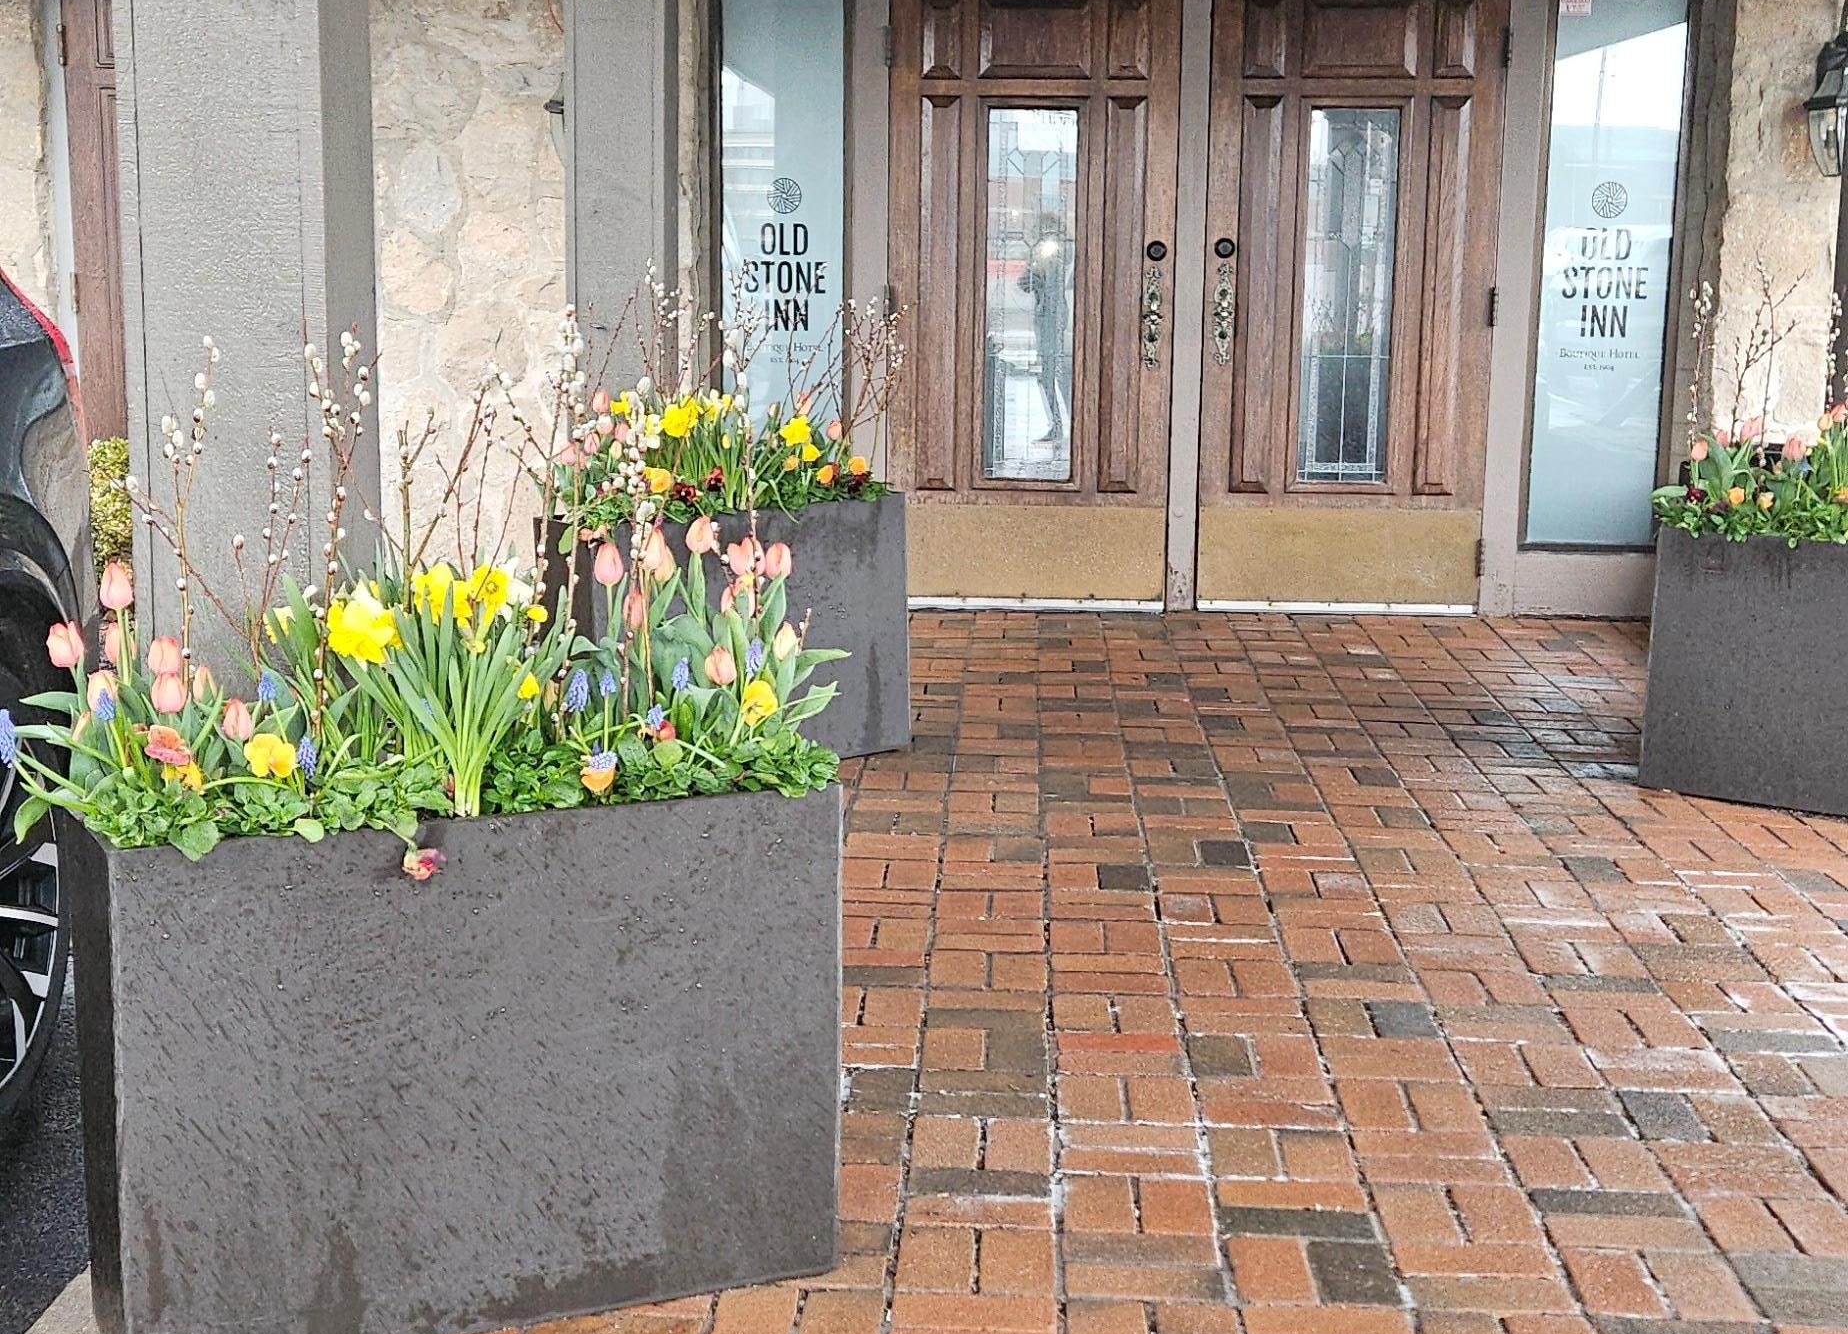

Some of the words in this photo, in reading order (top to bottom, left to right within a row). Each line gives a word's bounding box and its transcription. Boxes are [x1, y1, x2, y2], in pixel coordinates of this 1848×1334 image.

[761, 223, 808, 255] OLD
[1581, 227, 1631, 260] OLD
[744, 261, 827, 294] STONE
[1562, 267, 1648, 299] STONE
[765, 299, 808, 331] INN
[1580, 305, 1627, 337] INN
